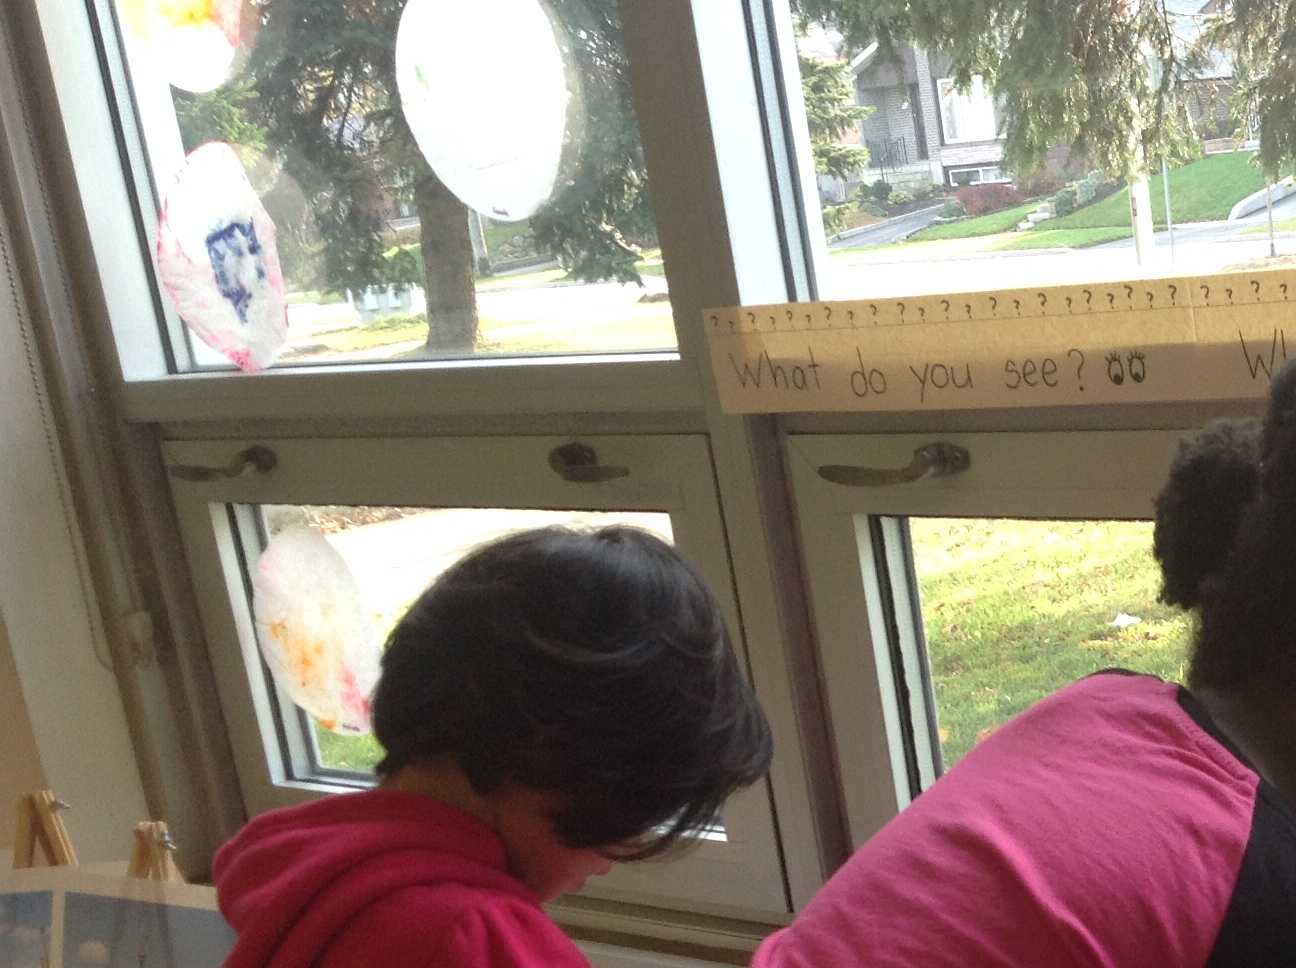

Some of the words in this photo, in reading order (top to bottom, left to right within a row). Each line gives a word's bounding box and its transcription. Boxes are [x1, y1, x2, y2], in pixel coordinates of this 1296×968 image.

[727, 345, 821, 391] What
[849, 346, 888, 399] do
[908, 361, 974, 404] you
